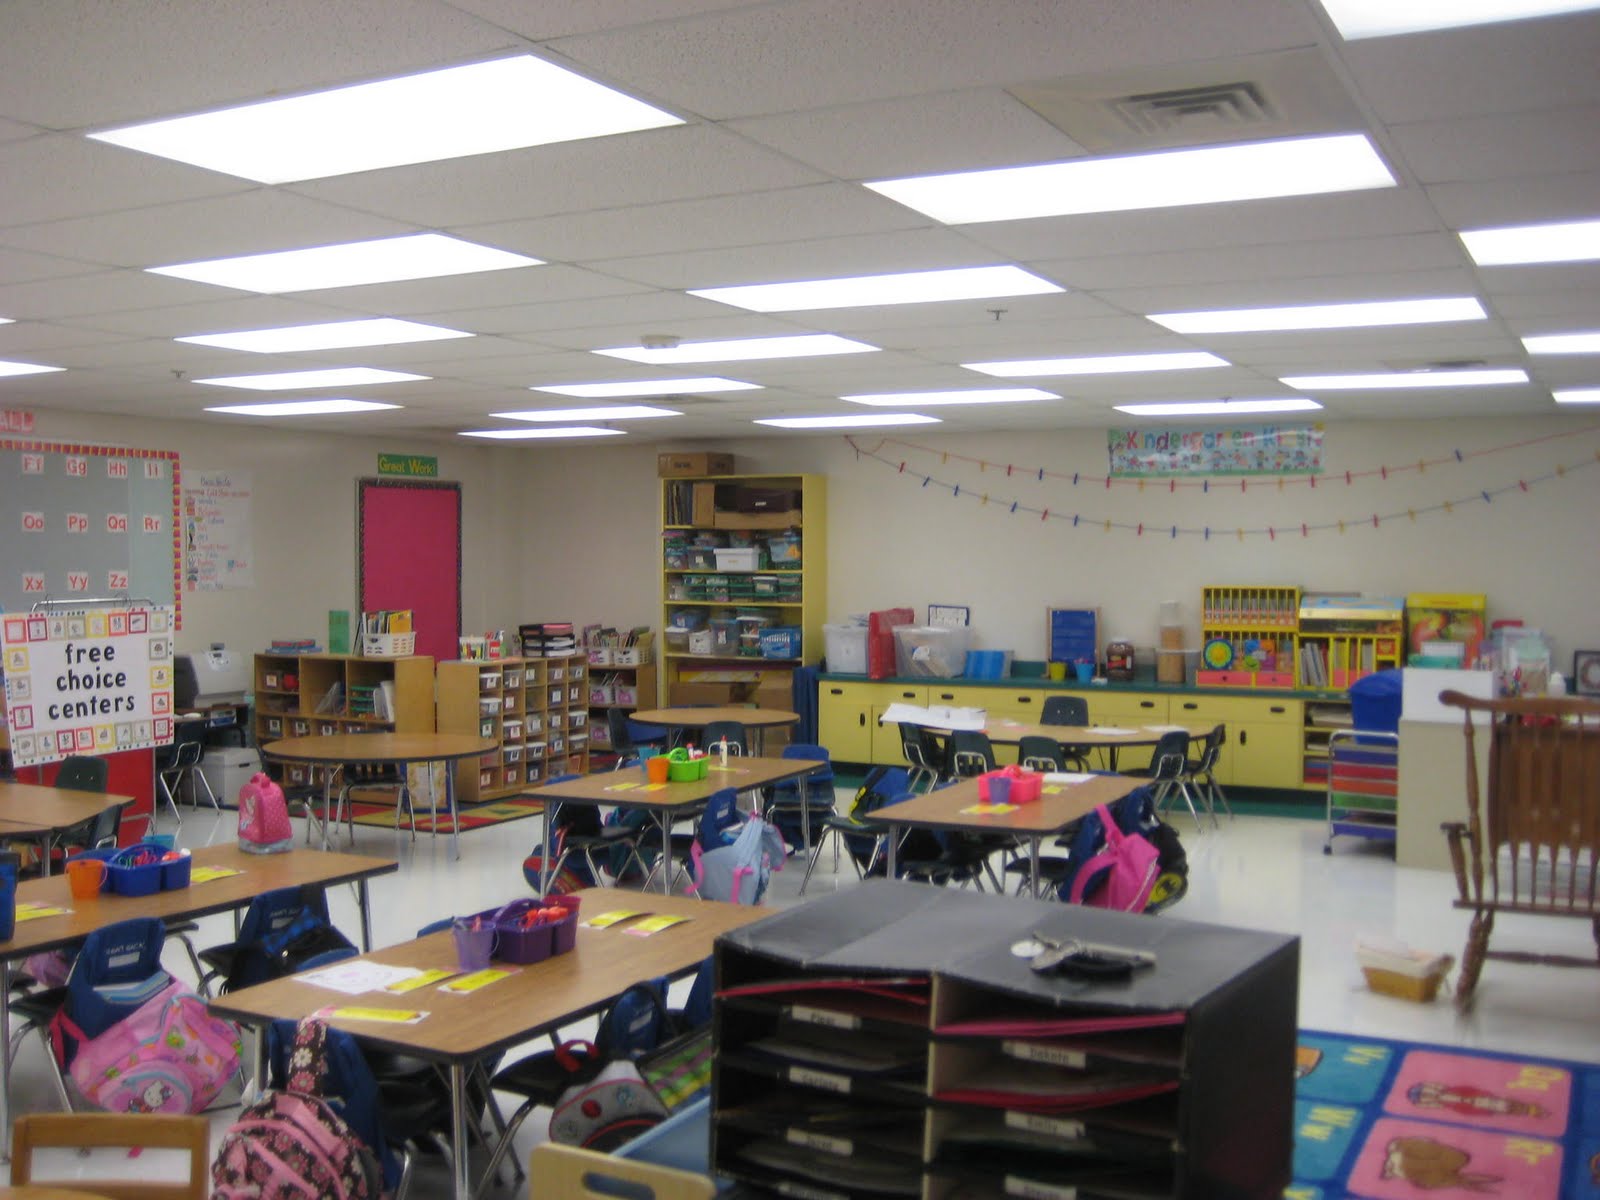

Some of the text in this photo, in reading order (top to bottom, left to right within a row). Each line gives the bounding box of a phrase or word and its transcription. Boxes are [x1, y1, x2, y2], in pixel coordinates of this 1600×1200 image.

[24, 459, 42, 471] Ff
[67, 459, 87, 475] Gg
[108, 462, 127, 475] Hh
[379, 456, 405, 472] Great
[24, 515, 160, 531] Oo Pp Qq Rr
[25, 574, 127, 590] Xx Yy Zz
[65, 643, 115, 664] free
[56, 666, 127, 691] choice
[48, 695, 135, 720] centers
